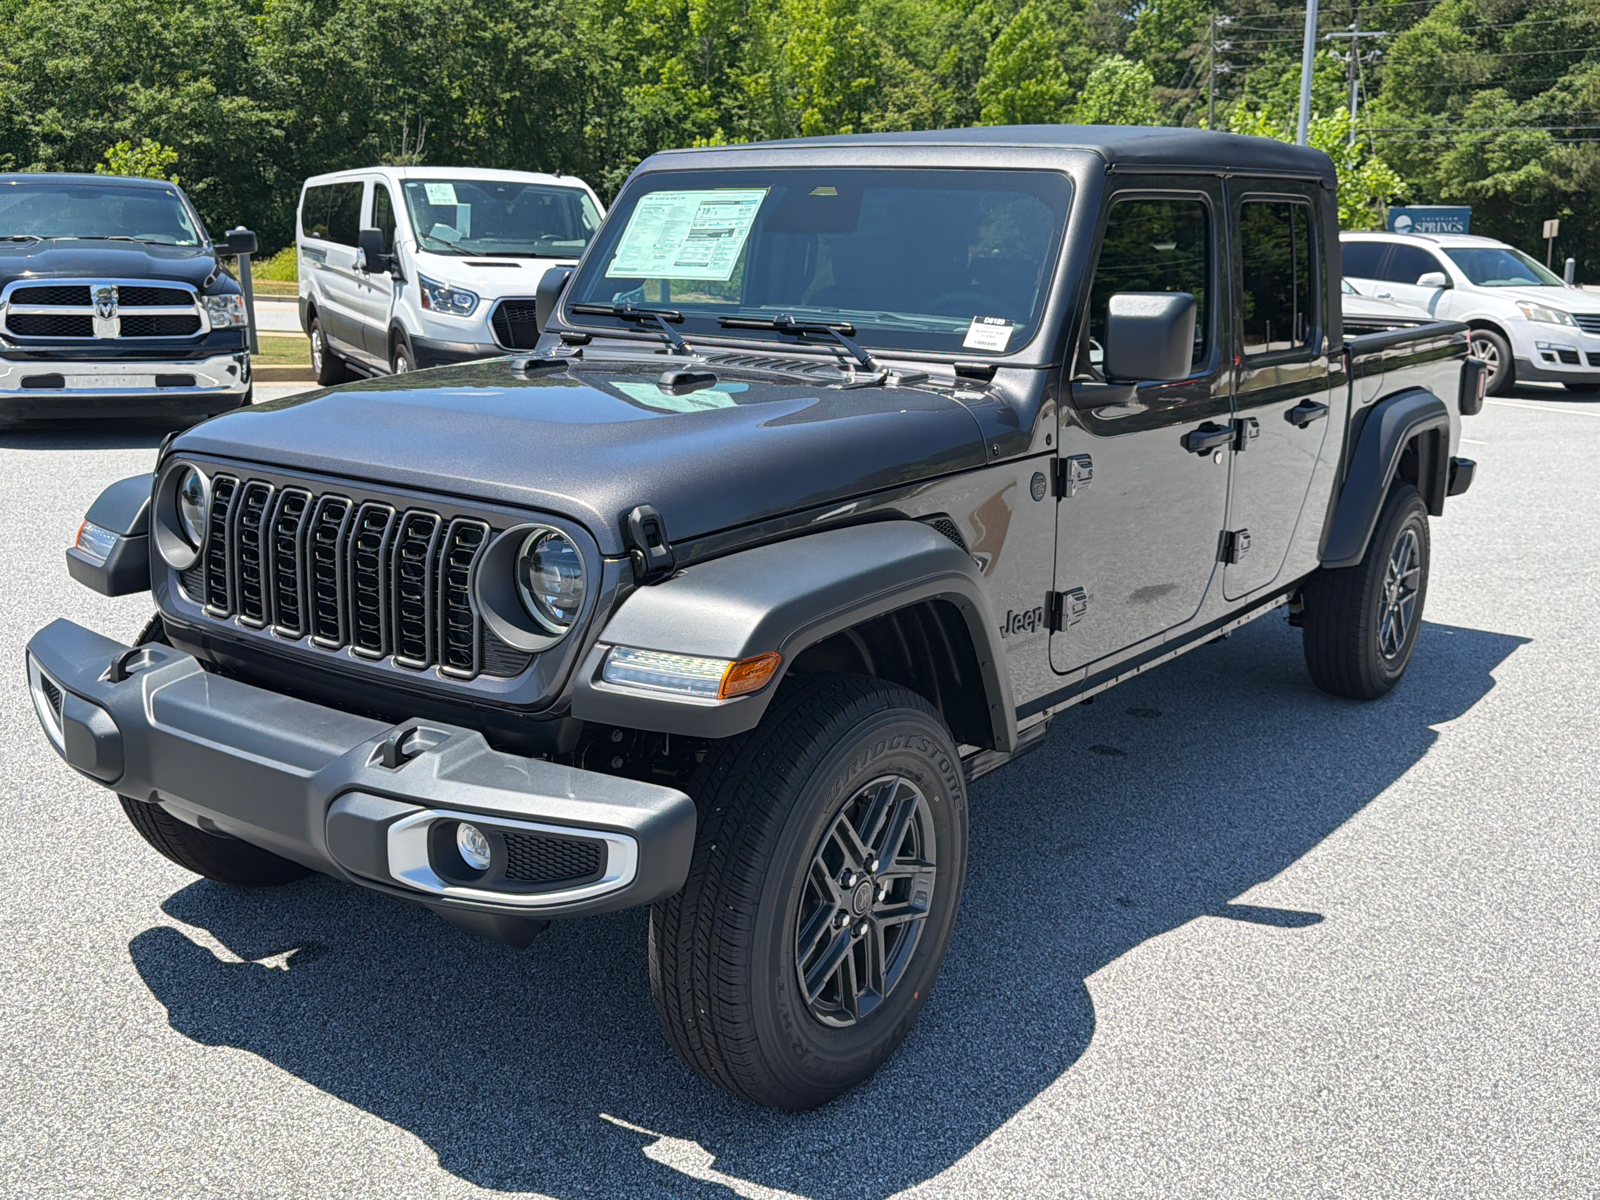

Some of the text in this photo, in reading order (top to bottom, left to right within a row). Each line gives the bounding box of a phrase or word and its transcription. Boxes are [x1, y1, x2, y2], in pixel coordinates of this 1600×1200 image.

[1414, 221, 1464, 233] SPRINGS
[999, 606, 1043, 638] Jeep
[823, 731, 964, 812] BRIDGESTONE
